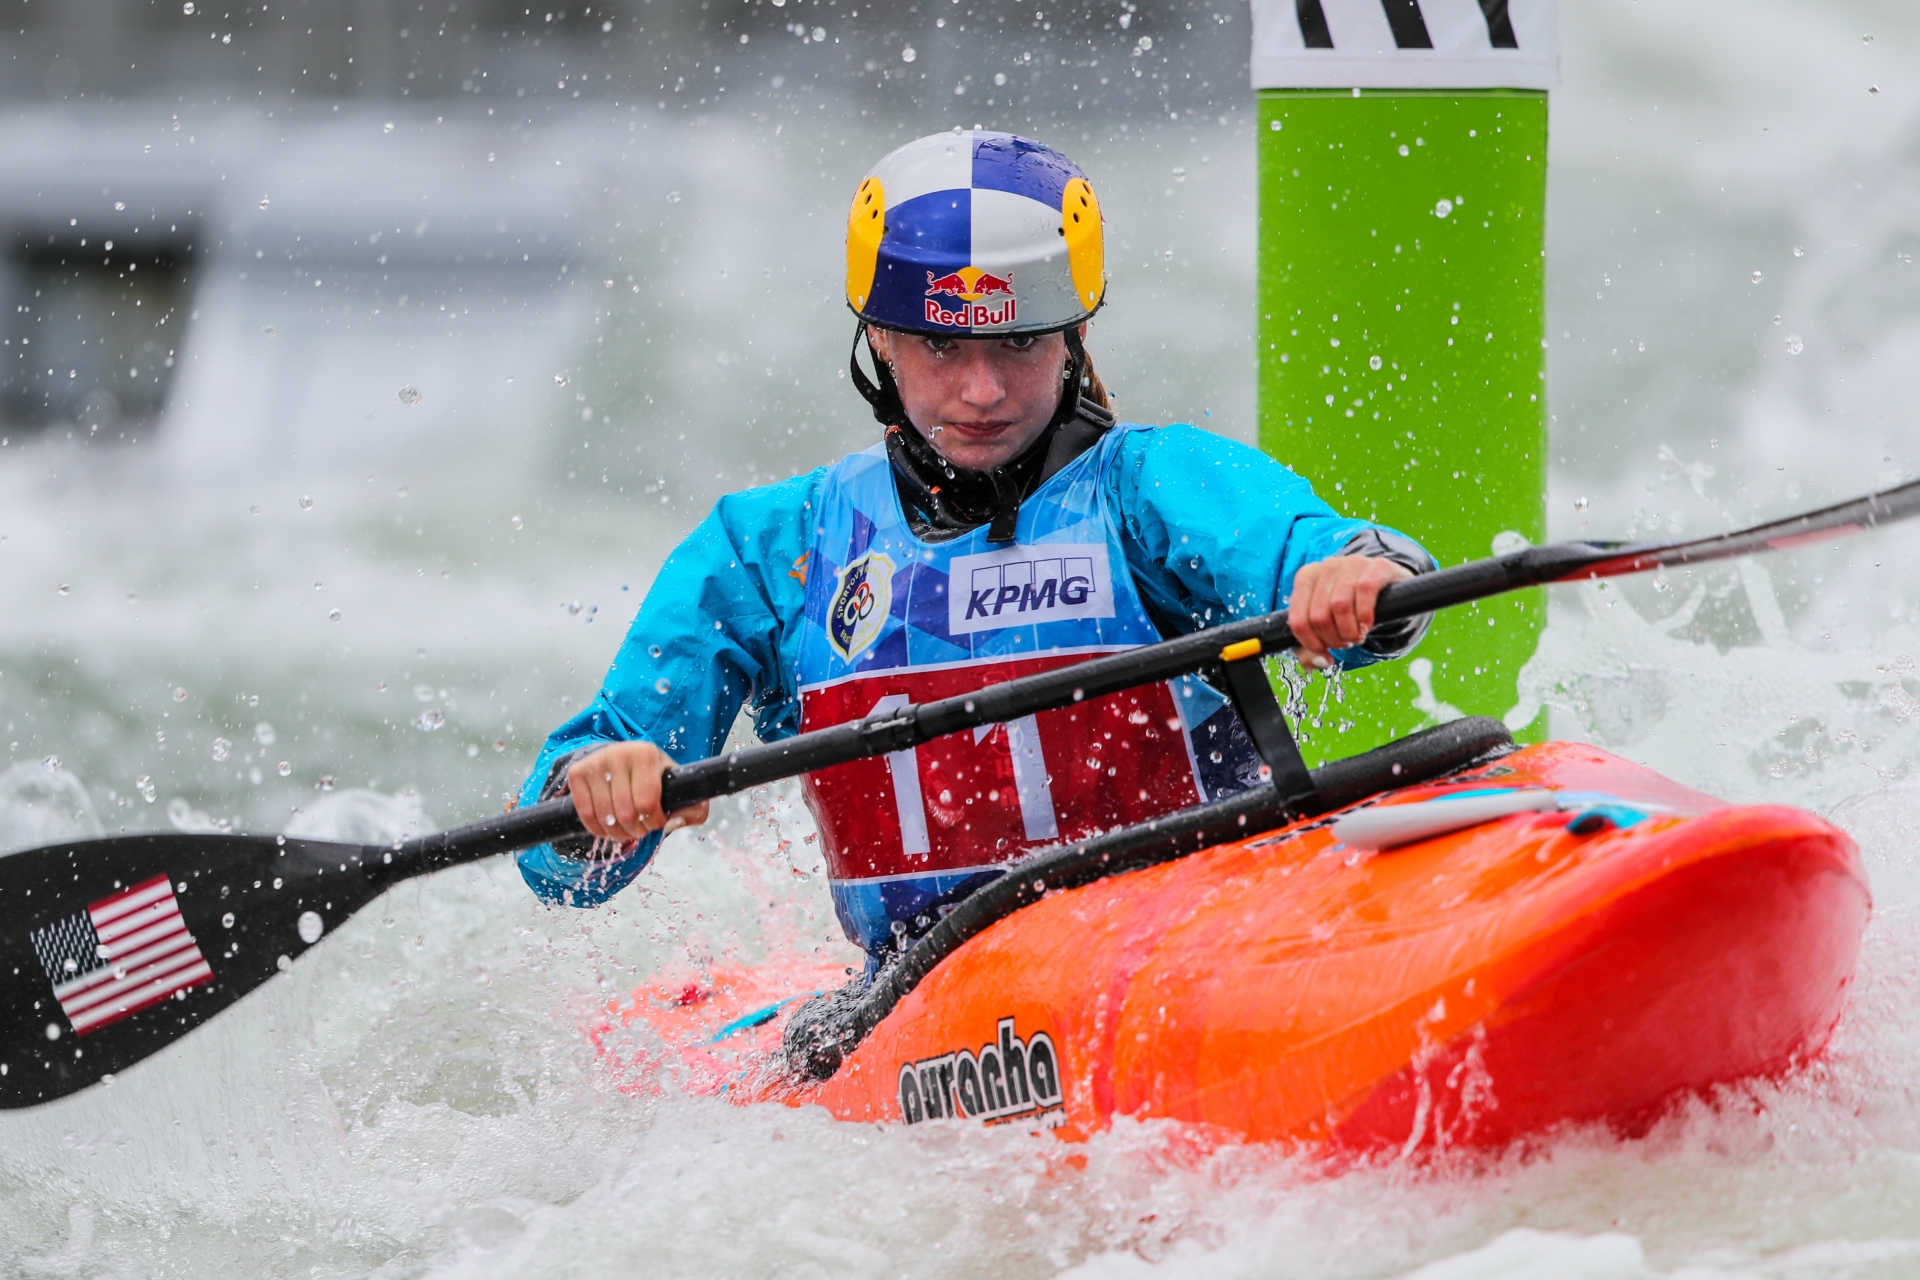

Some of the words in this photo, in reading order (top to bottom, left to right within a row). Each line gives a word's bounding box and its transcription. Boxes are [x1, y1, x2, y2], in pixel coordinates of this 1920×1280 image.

[925, 299, 970, 327] Red
[973, 299, 1017, 326] Bull
[965, 576, 1089, 620] KPMG
[866, 693, 1060, 856] 11
